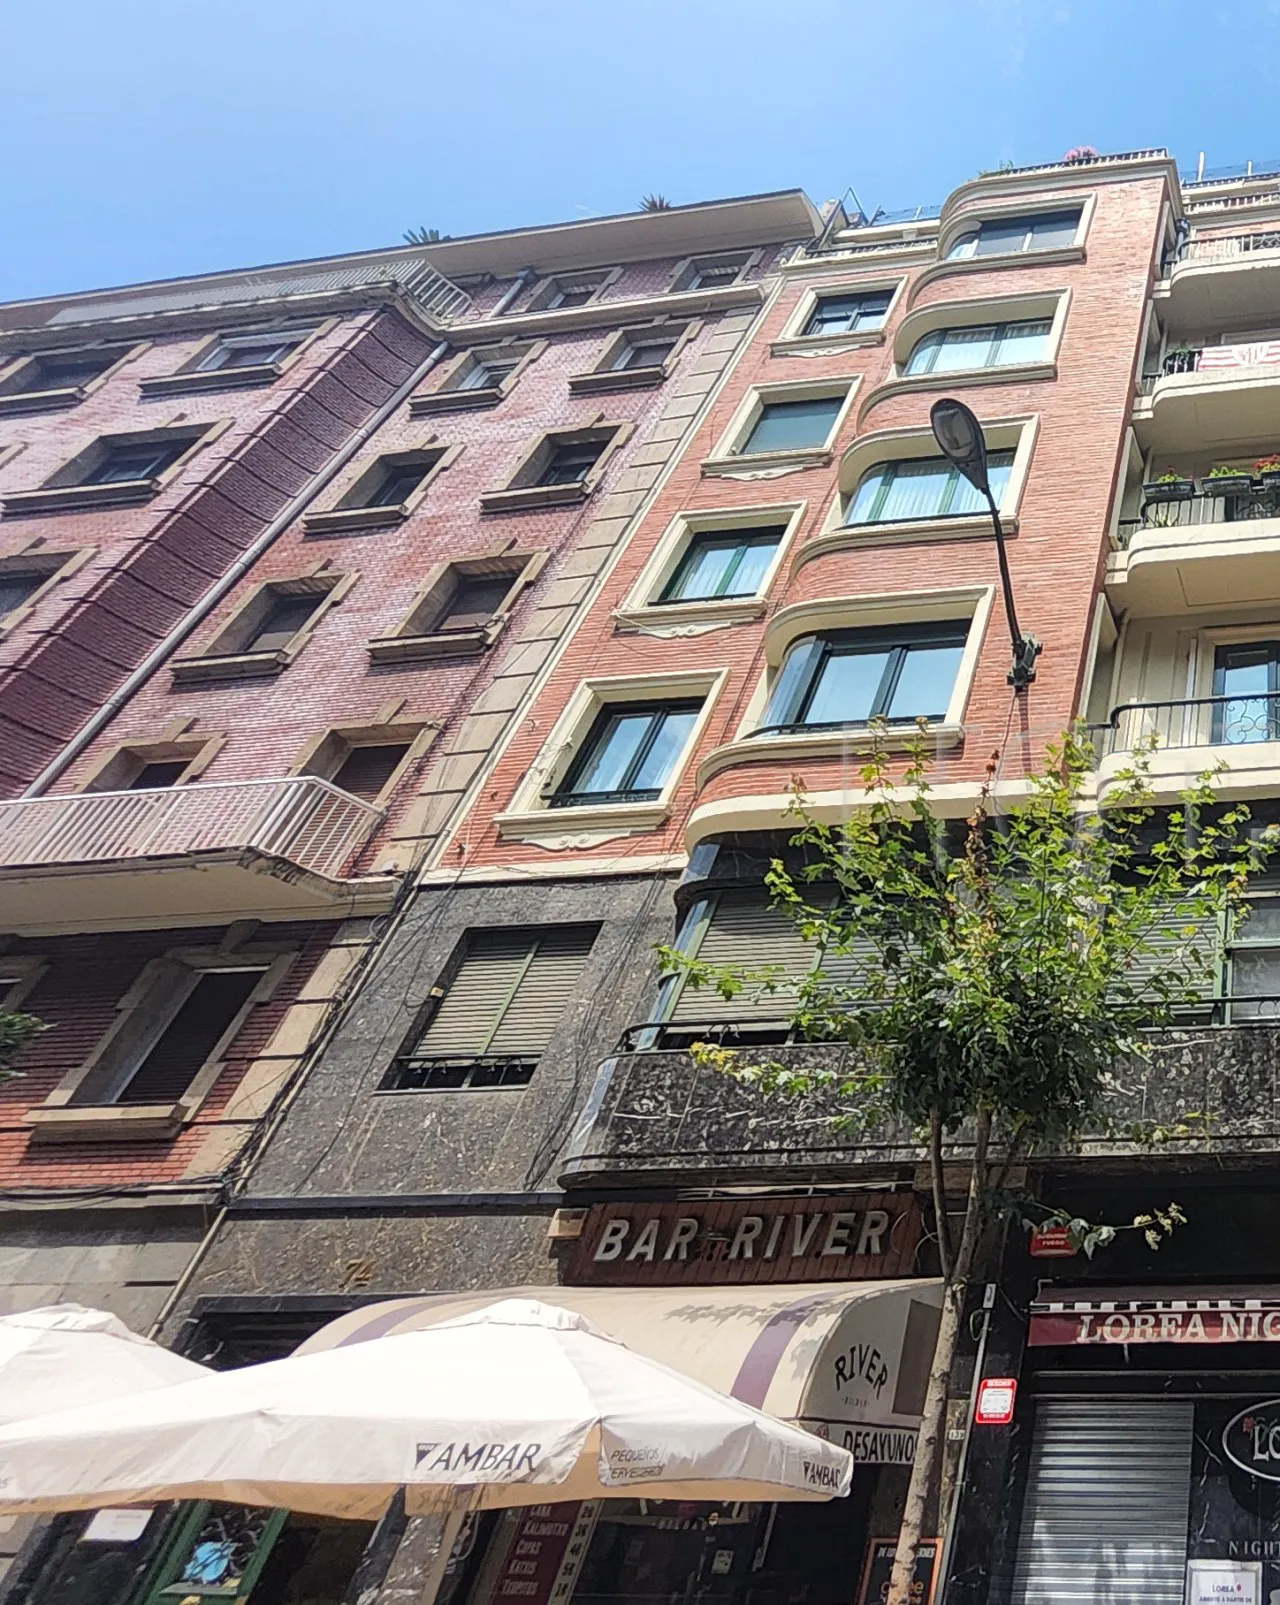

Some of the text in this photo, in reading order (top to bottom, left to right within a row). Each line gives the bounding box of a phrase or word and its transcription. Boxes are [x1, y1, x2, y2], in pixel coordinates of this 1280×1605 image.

[592, 1210, 889, 1262] BAR RIVER
[1076, 1313, 1209, 1344] LOREA
[835, 1344, 888, 1400] RIVER
[428, 1443, 542, 1473] AMBAR
[843, 1430, 918, 1462] DESAYUNO
[1212, 1584, 1235, 1593] LOREA
